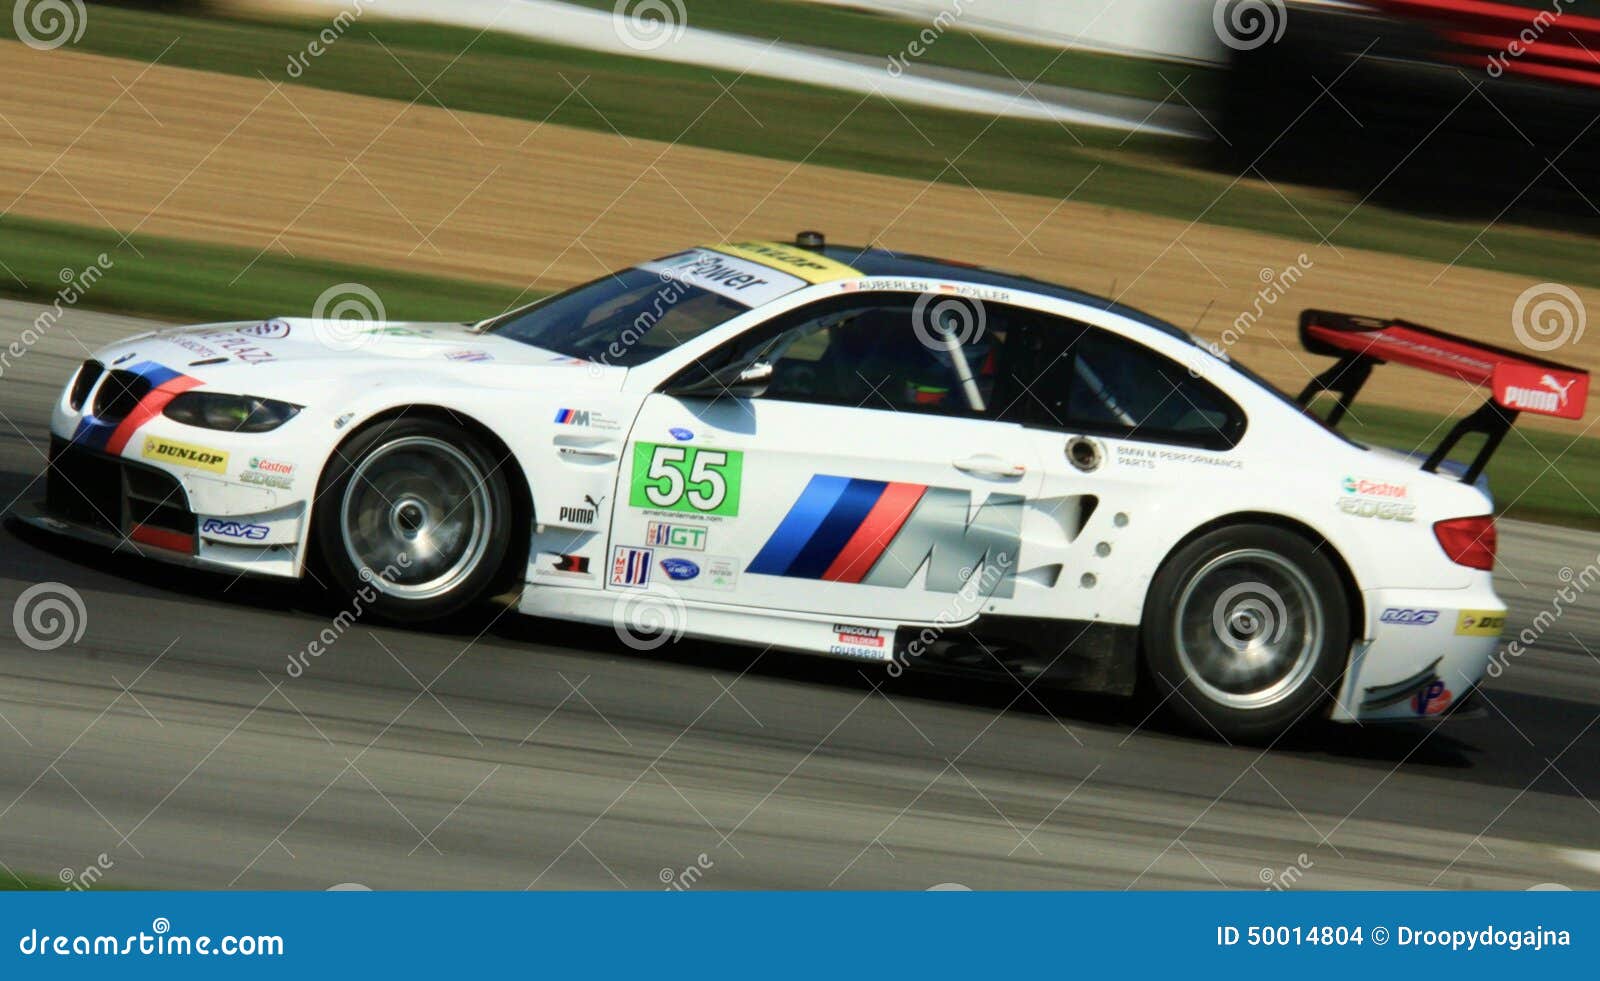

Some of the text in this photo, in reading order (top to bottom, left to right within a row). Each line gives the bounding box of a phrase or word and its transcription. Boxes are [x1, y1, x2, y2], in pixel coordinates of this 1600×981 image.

[1503, 386, 1560, 412] PUMA
[157, 444, 225, 465] DUNLOP
[1118, 457, 1155, 469] PARTS
[259, 459, 293, 475] Castrol
[644, 445, 728, 512] 55
[1360, 480, 1407, 498] Castrol
[559, 506, 595, 525] PUMA
[202, 519, 270, 540] RAYS
[671, 527, 704, 547] GT
[613, 548, 626, 583] IMSA
[1379, 608, 1440, 625] RAYS
[834, 624, 877, 637] LINCOLN
[831, 645, 885, 659] rousseau
